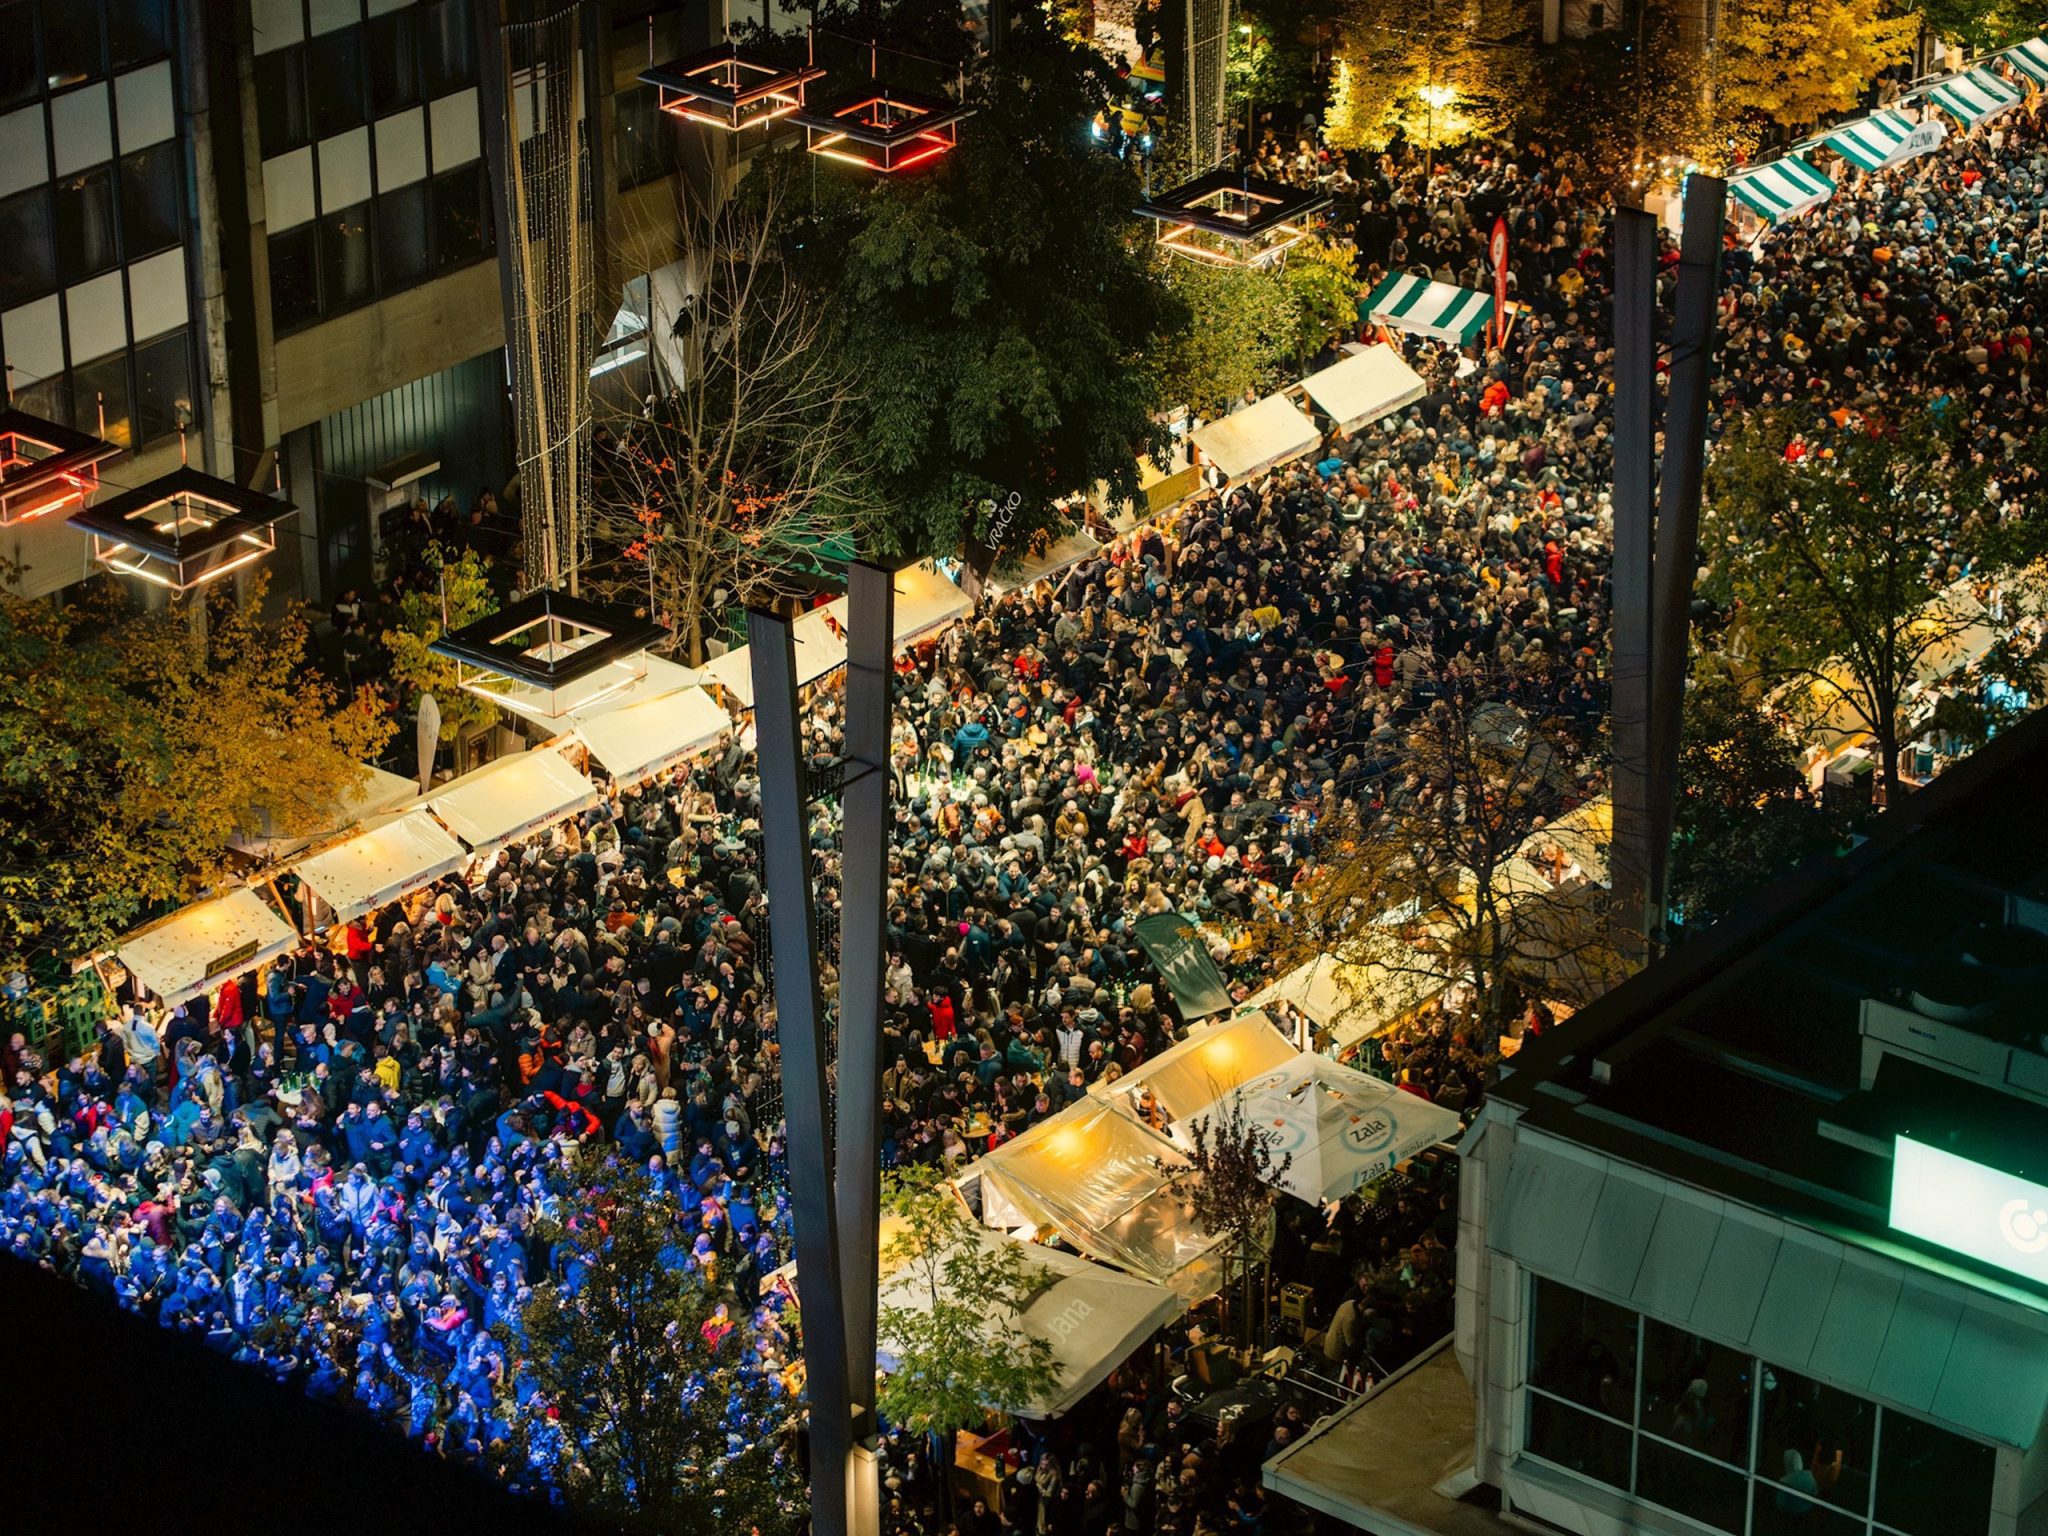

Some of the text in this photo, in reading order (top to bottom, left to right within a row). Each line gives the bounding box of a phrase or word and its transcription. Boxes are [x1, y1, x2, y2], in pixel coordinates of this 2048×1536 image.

[985, 491, 1022, 551] VRAČKO
[1350, 1119, 1386, 1142] Zala
[1361, 1161, 1386, 1183] Zala
[1046, 1298, 1094, 1345] Jana
